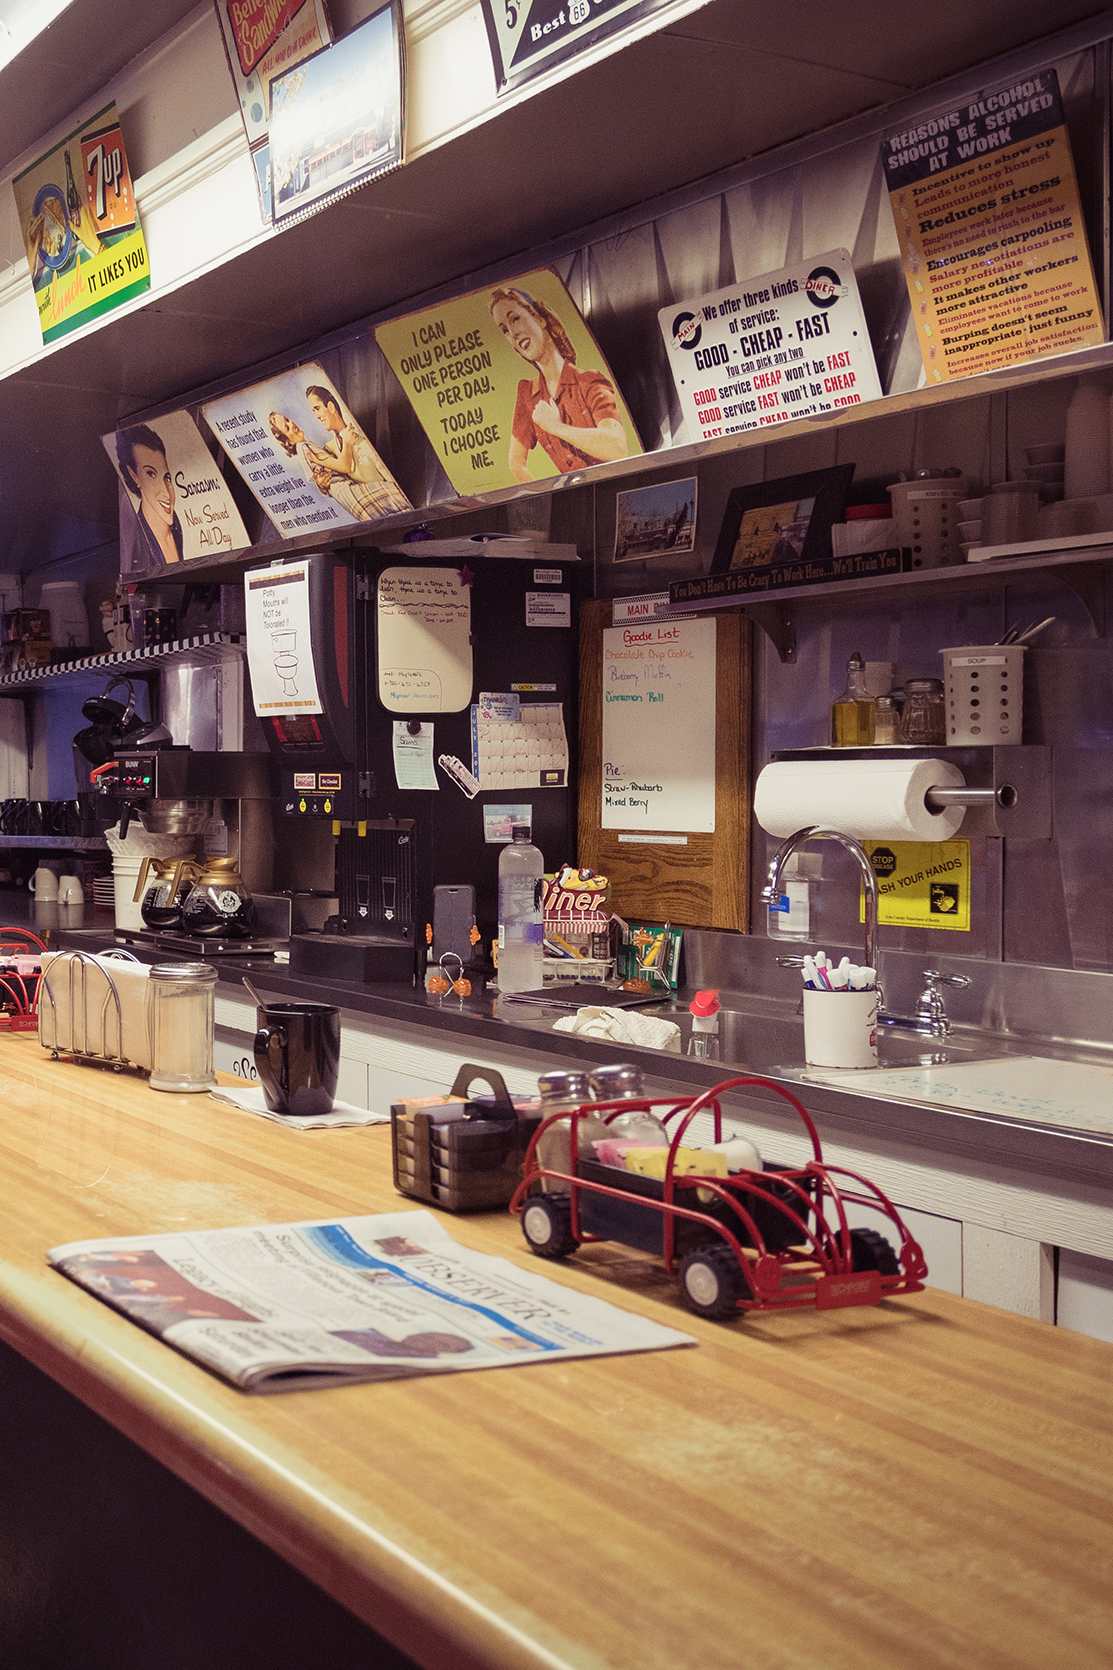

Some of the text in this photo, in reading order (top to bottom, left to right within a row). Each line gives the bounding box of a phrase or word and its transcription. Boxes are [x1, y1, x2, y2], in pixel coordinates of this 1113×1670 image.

[530, 10, 566, 42] Best
[573, 3, 586, 21] 66
[889, 78, 1046, 151] REASONS ALCOHOL
[887, 93, 1054, 170] SHOULD BE SERVED
[929, 127, 1013, 172] AT WORK
[919, 175, 1061, 232] Reduces stress
[926, 217, 1073, 272] Encourages carpooling
[47, 254, 87, 323] lunch
[87, 275, 98, 294] IT
[98, 264, 125, 288] LIKES
[125, 247, 145, 273] YOU
[805, 278, 835, 295] DINER
[933, 254, 1079, 305] It makes other workers
[702, 278, 799, 321] We offer three kinds
[412, 320, 447, 347] I CAN
[678, 322, 696, 342] MAIN
[728, 308, 780, 334] of service:
[400, 329, 485, 376] ONLY PLEASE
[694, 312, 831, 371] GOOD CHEAP FAST
[412, 351, 493, 394] ONE PERSON
[725, 346, 804, 378] You can pick any two
[437, 375, 496, 408] PER DAY.
[693, 351, 852, 406] GOOD service CHEAP won't be FAST
[698, 371, 857, 425] GOOD service FAST won't be CHEAP
[216, 410, 258, 433] A recent study
[439, 406, 485, 435] TODAY
[225, 427, 268, 449] has found that
[442, 424, 501, 457] I CHOOSE
[471, 450, 495, 470] ME.
[174, 471, 221, 499] Sarcasm:
[184, 502, 230, 527] Now Served
[280, 507, 339, 530] men who mention it
[199, 526, 233, 550] All Day
[674, 584, 687, 597] You
[688, 580, 707, 596] Don't
[707, 578, 725, 593] Have
[726, 576, 737, 590] To
[737, 575, 749, 588] Be
[748, 573, 769, 590] Crazy
[772, 570, 784, 584] To
[784, 566, 804, 583] Work
[855, 556, 878, 572] Train
[879, 553, 897, 569] You
[262, 589, 276, 598] Potty
[262, 597, 289, 608] Mouths will
[262, 611, 274, 619] NOT
[627, 603, 649, 616] MAIN
[623, 627, 680, 643] Goodie List
[605, 649, 694, 661] Chocolate Chip Cookie
[606, 691, 664, 702] Cinnamon Roll
[605, 797, 648, 815] Mixed Berry
[898, 872, 924, 888] YOUR
[925, 859, 962, 878] HANDS
[399, 1256, 551, 1320] OBSERVER
